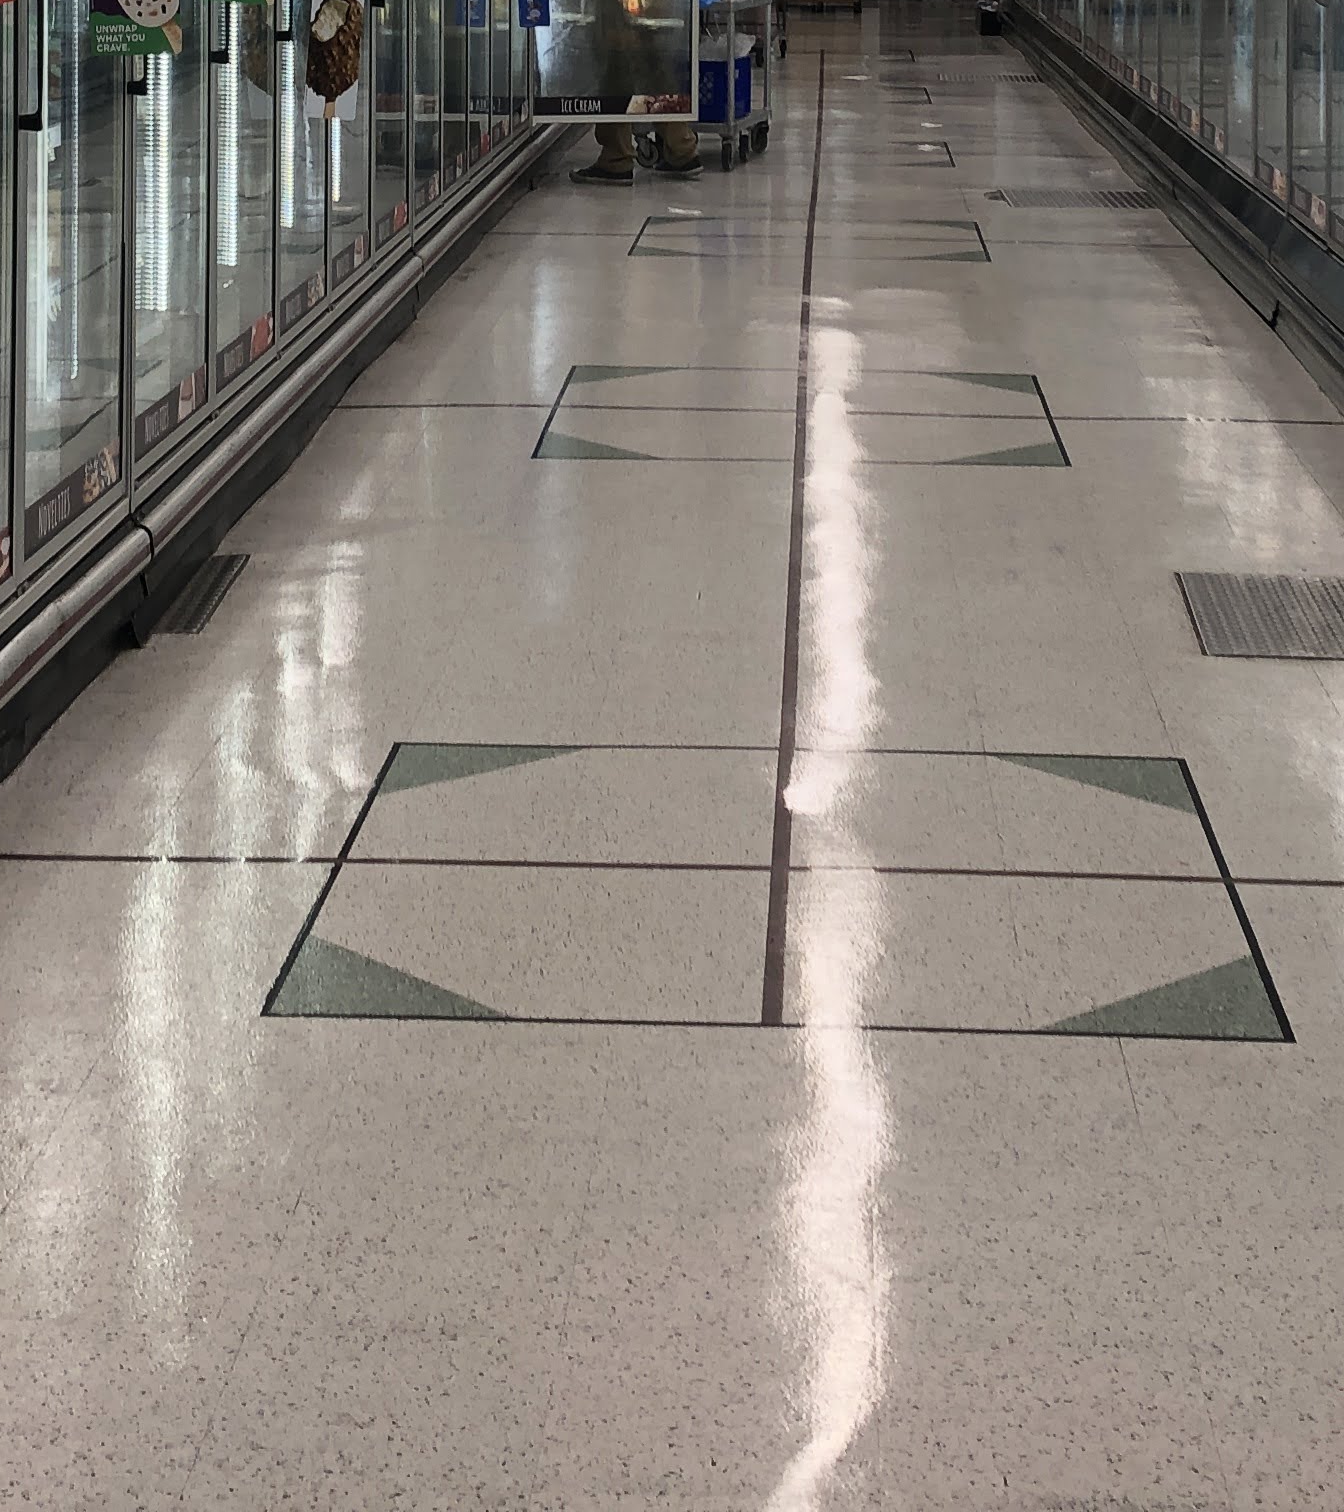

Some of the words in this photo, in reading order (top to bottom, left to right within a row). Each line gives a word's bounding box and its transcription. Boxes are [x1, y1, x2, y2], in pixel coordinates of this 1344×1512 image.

[95, 23, 138, 35] UNWRAP
[95, 33, 124, 44] WHAT
[125, 31, 147, 43] YOU
[96, 42, 131, 54] CRAVE.
[560, 97, 573, 114] ICE
[574, 96, 602, 114] CREAM
[37, 486, 72, 537] NOVELTIES
